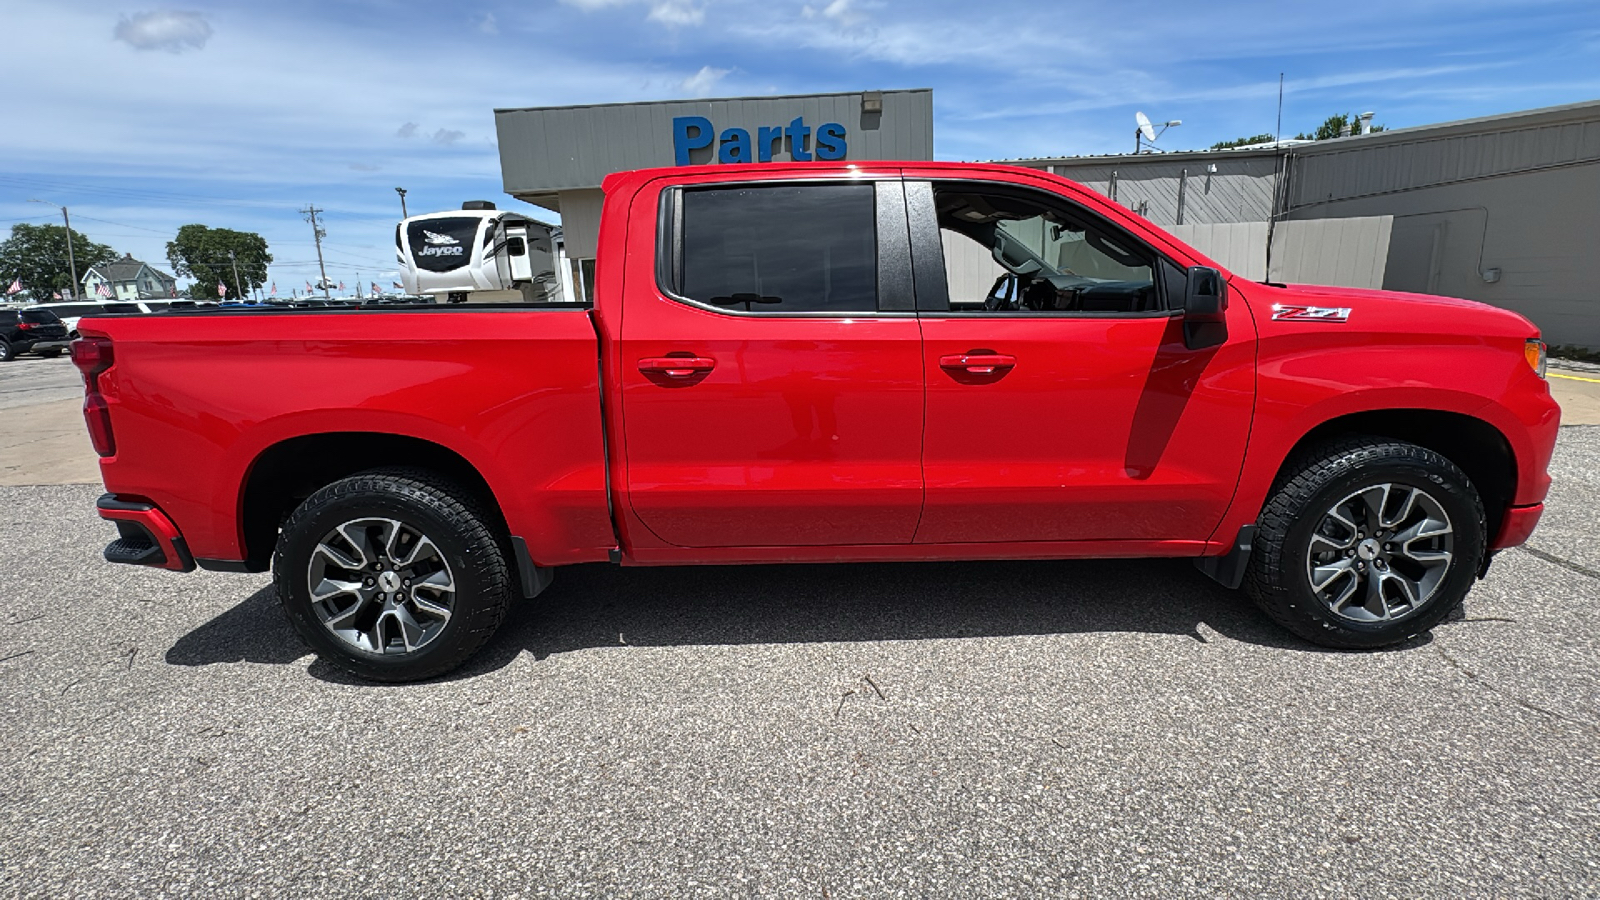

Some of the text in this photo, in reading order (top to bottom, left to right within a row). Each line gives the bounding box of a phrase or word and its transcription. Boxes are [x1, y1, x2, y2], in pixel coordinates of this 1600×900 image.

[673, 116, 847, 166] Parts
[419, 245, 463, 257] Jayco
[1271, 304, 1352, 322] Z71
